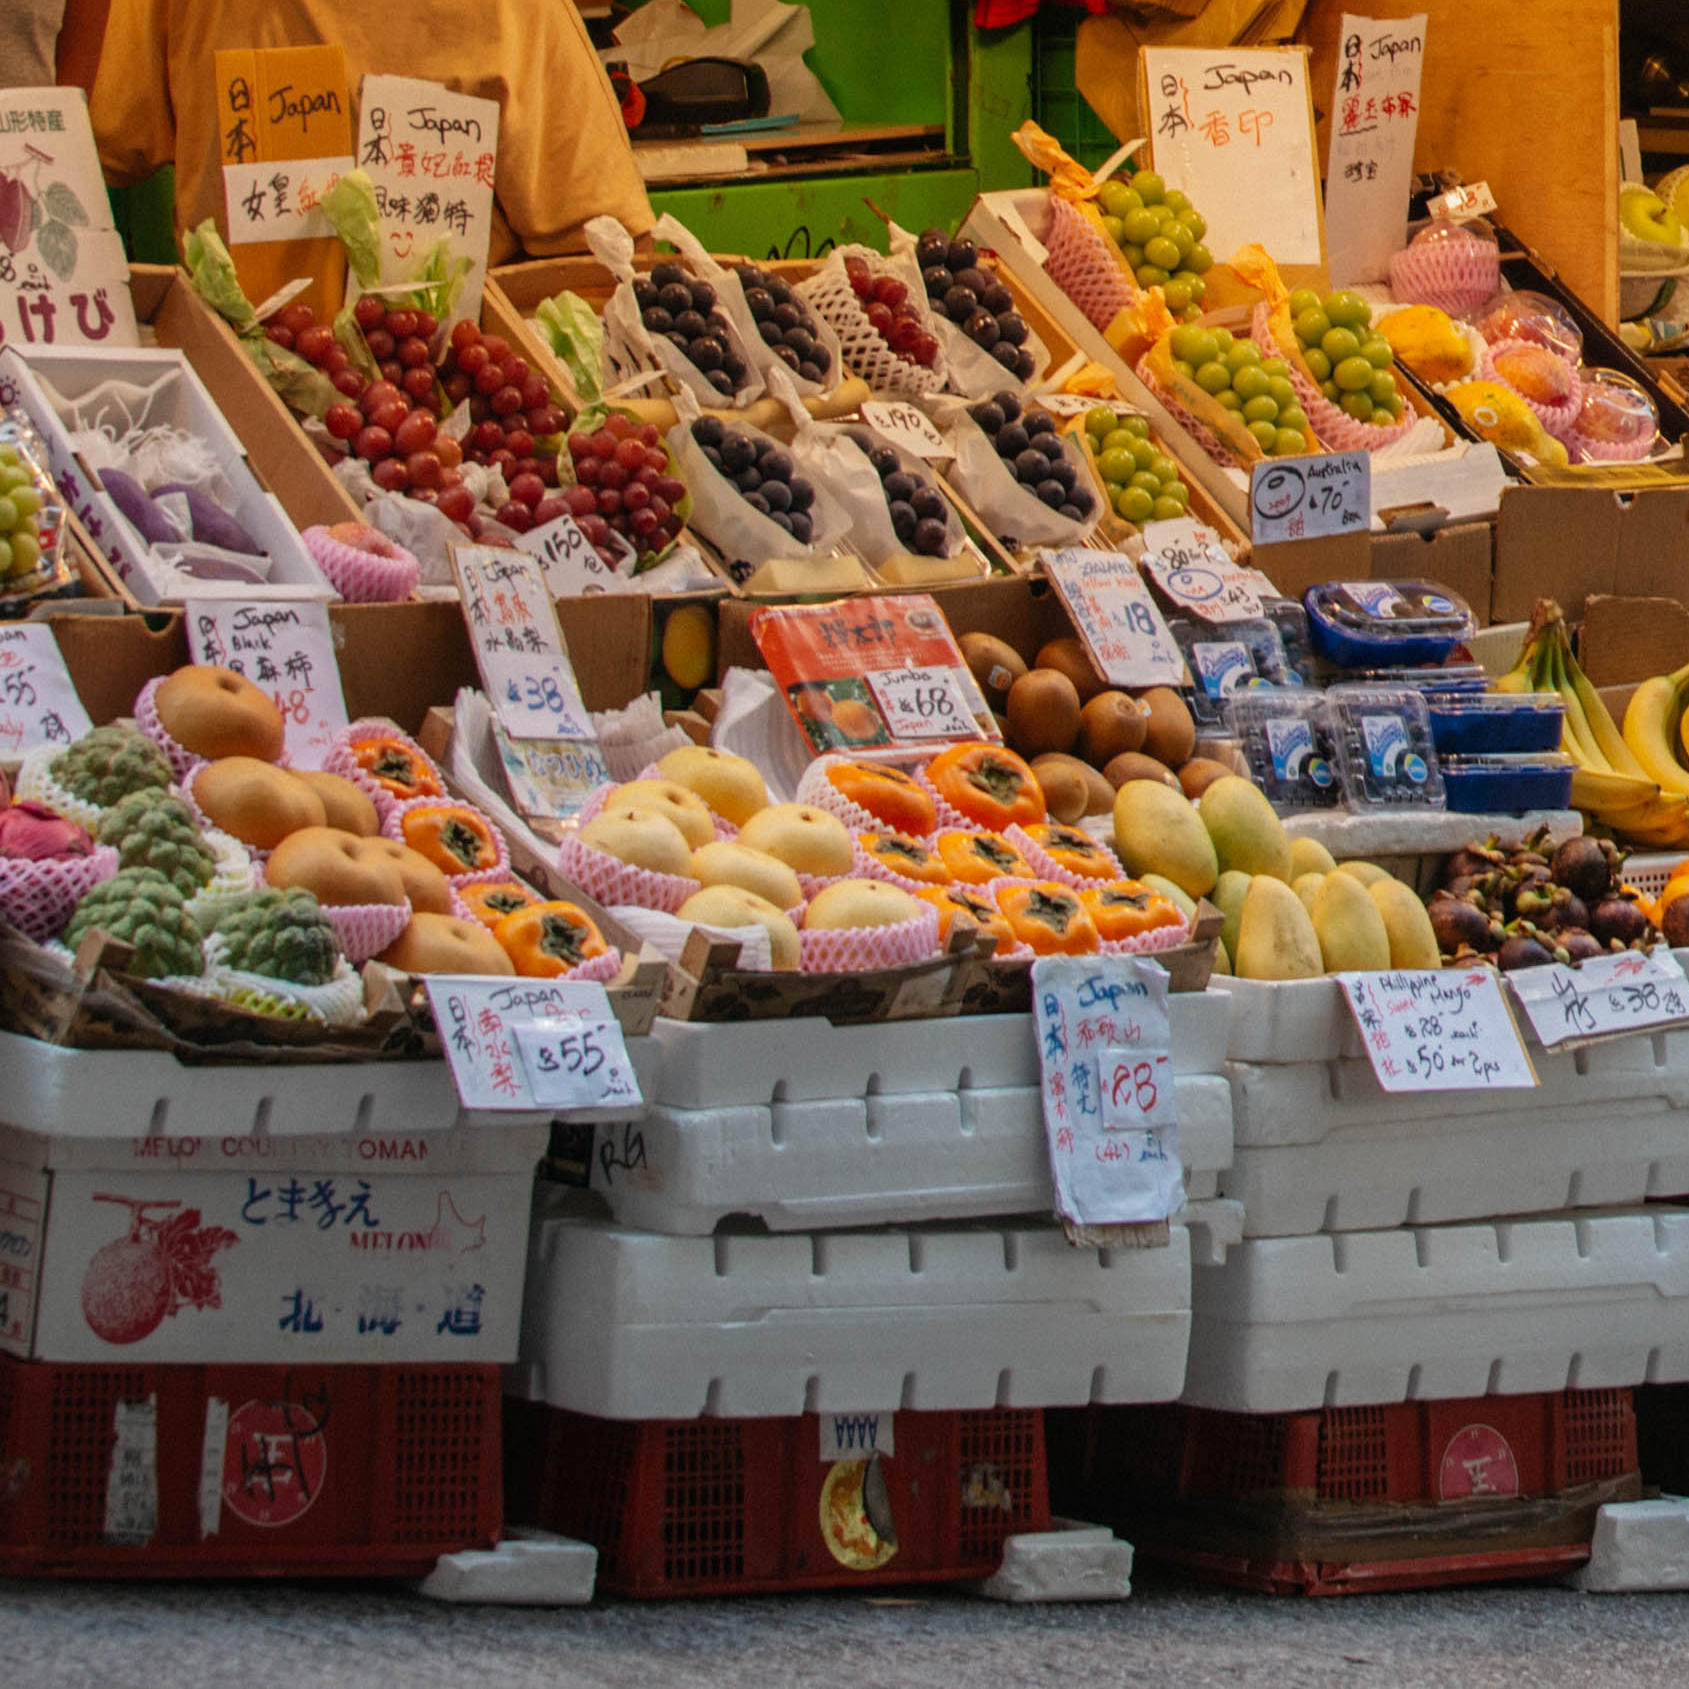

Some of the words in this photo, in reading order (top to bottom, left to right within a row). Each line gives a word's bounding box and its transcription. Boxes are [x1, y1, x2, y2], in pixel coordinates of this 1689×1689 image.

[1339, 35, 1361, 92] 日本
[1369, 34, 1421, 62] Japan
[1204, 64, 1292, 94] Japan
[226, 78, 256, 164] 日本
[268, 86, 341, 132] Japan
[1159, 74, 1188, 138] 日本
[362, 108, 388, 166] 日本
[407, 108, 481, 144] Japan
[1201, 109, 1273, 146] 香印
[1307, 459, 1363, 479] Australia
[483, 560, 528, 592] Japan
[233, 608, 299, 634] Japan
[198, 614, 221, 666] 日本
[486, 627, 548, 652] 水晶梨
[489, 986, 565, 1017] Japan
[1078, 975, 1148, 1011] Japan
[1430, 986, 1472, 1015] Mango
[1552, 971, 1597, 1035] 山竹
[448, 996, 475, 1062] 日本
[1044, 993, 1065, 1064] 日本
[1076, 1014, 1142, 1049] 和歌山
[349, 1231, 432, 1251] MELON
